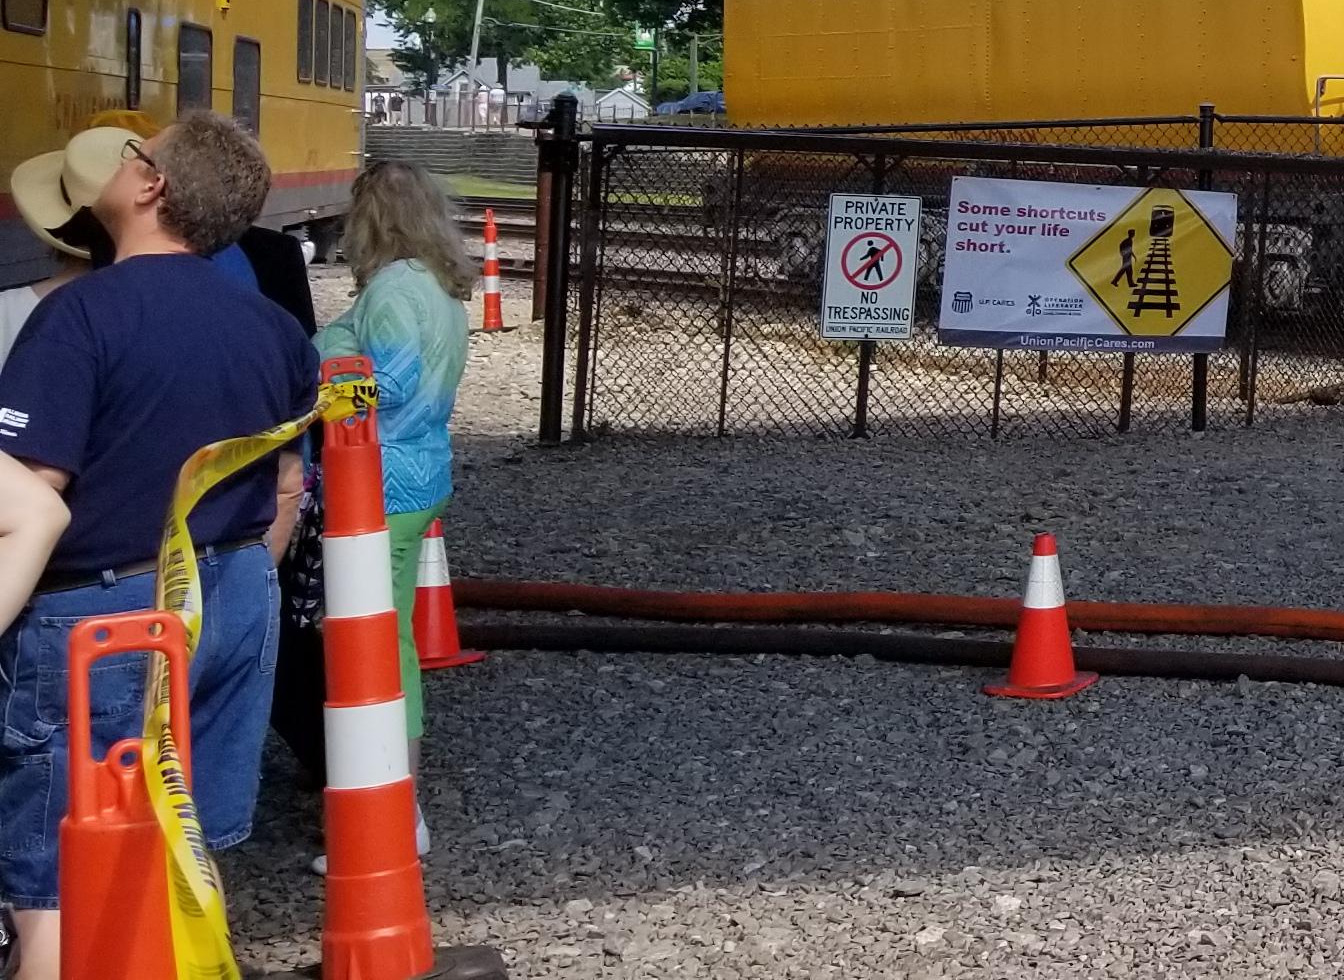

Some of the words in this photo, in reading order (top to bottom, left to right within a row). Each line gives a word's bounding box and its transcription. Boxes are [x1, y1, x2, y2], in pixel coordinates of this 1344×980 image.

[844, 201, 907, 216] PRIVATE
[957, 201, 1011, 216] Some
[1016, 204, 1107, 222] shortcuts
[833, 216, 915, 232] PROPERTY
[957, 220, 989, 233] cut
[993, 222, 1036, 237] your
[1040, 223, 1070, 237] life
[955, 238, 1011, 254] short.
[860, 291, 878, 305] NO
[827, 306, 910, 321] TRESPASSING
[1020, 335, 1155, 350] UnionPacificCares.com
